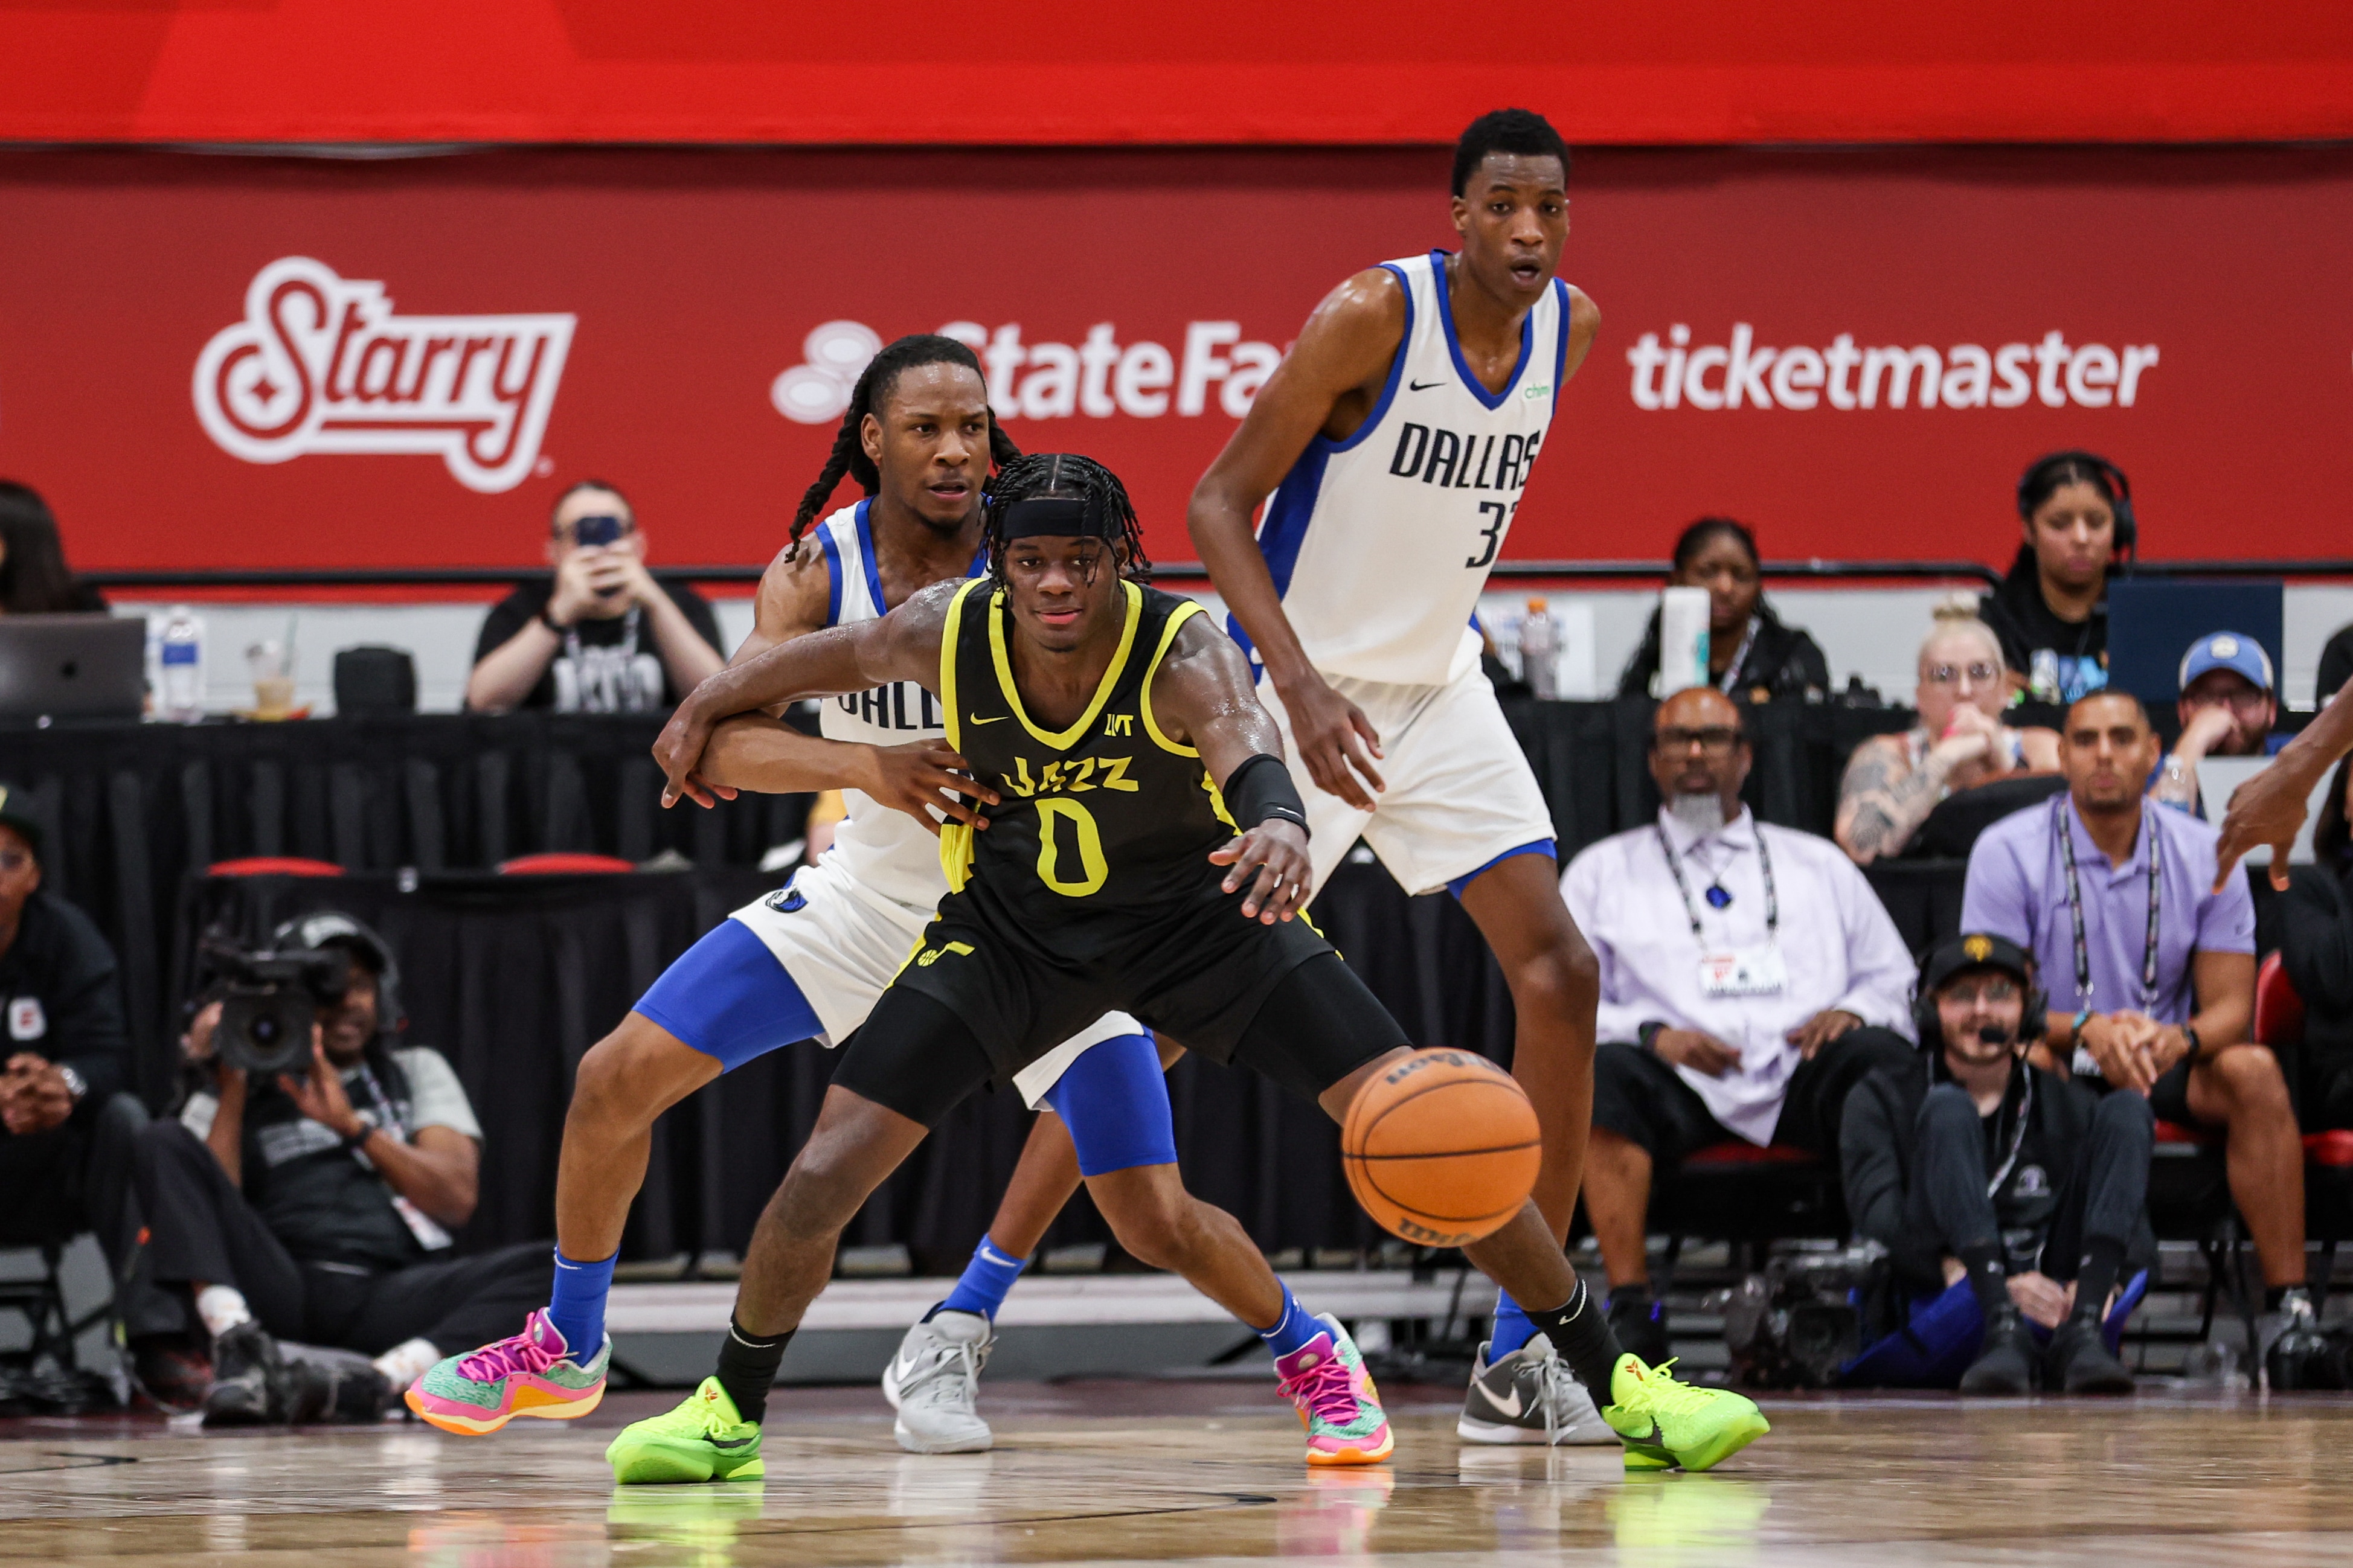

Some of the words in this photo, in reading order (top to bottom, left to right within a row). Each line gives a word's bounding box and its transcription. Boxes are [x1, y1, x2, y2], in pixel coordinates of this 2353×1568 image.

[199, 262, 571, 487] Starry
[1626, 322, 2160, 410] ticketmaster
[1389, 421, 1540, 490] DALLAS
[1466, 501, 1518, 568] 3
[1000, 756, 1139, 797] JAZZ
[1035, 797, 1108, 897] 0
